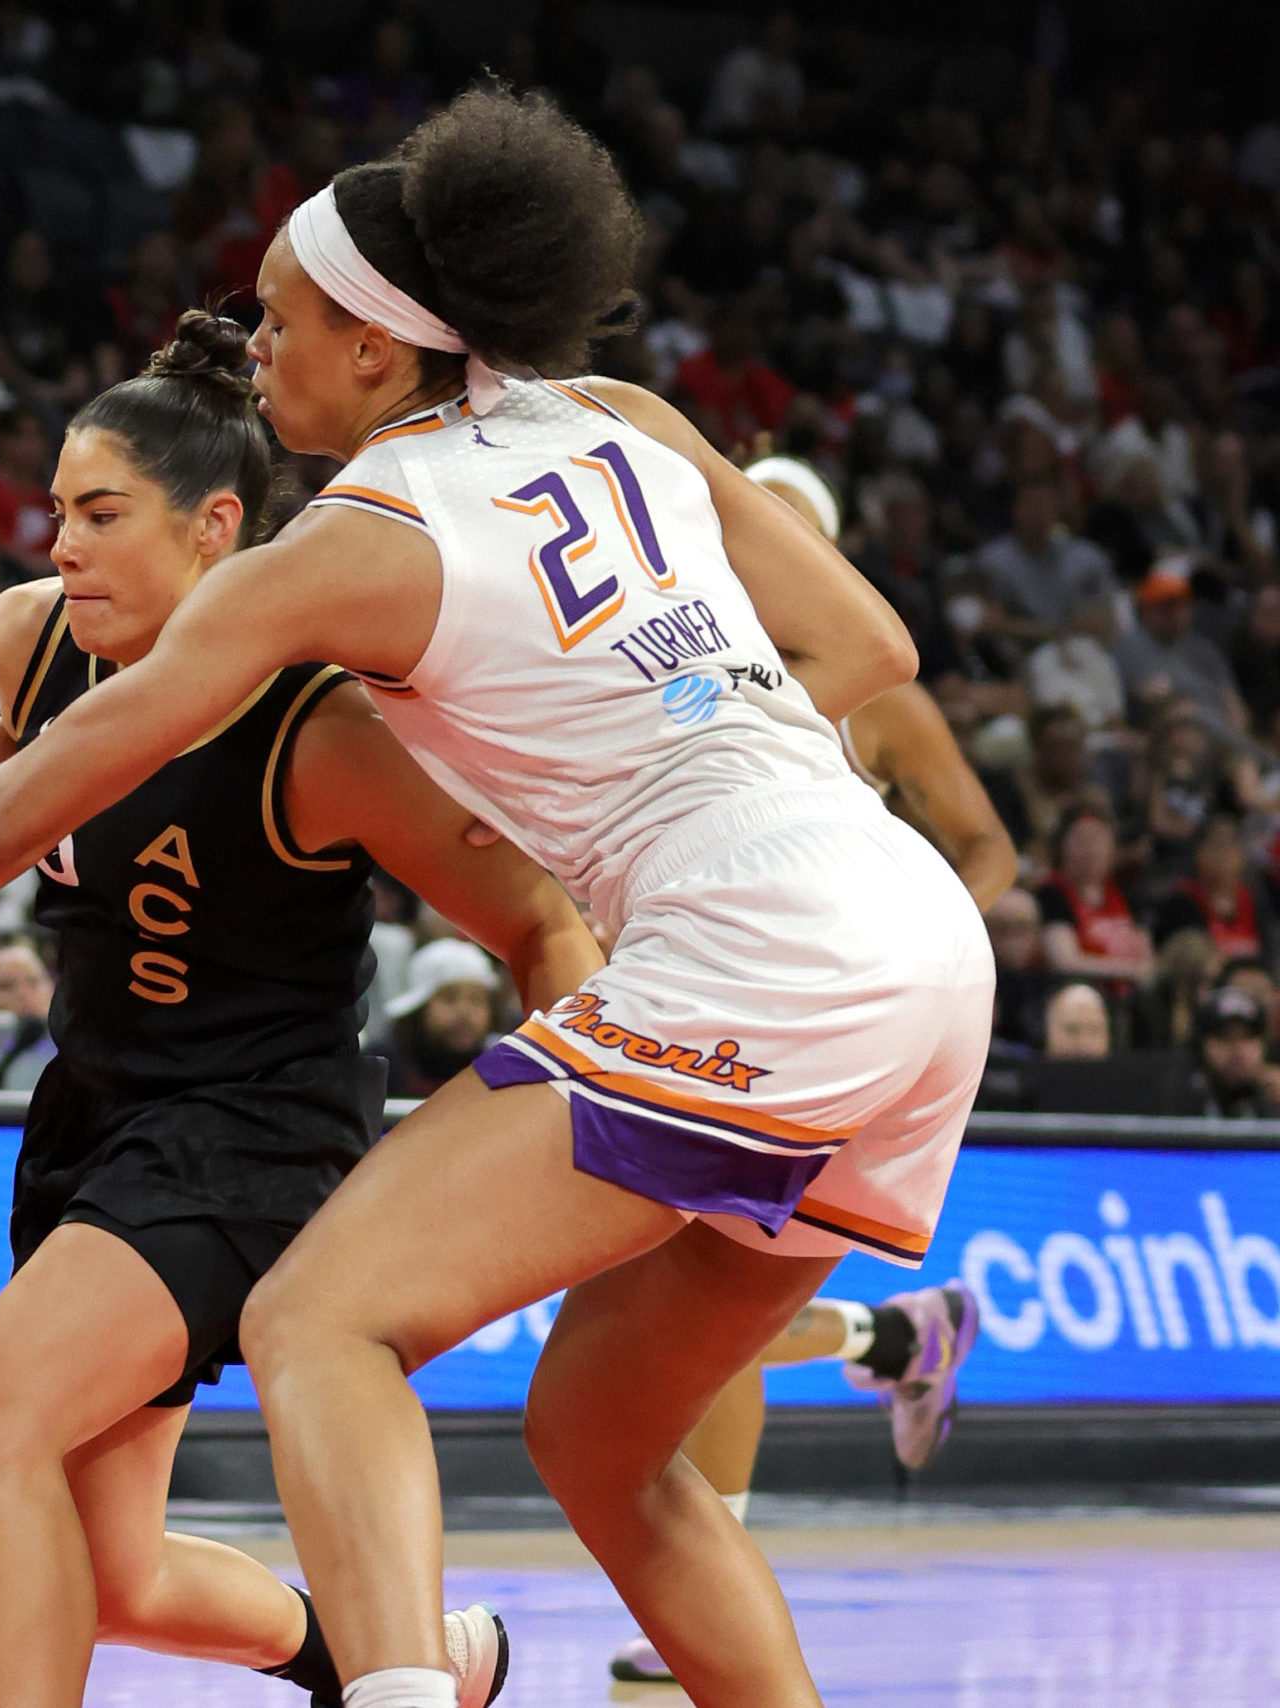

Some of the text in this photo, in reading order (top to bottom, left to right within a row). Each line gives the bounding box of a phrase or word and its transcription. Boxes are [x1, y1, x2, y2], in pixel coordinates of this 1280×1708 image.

[491, 441, 676, 654] 21
[610, 599, 731, 683] TURNER
[128, 824, 200, 1004] ACS
[544, 993, 773, 1092] Phoenix
